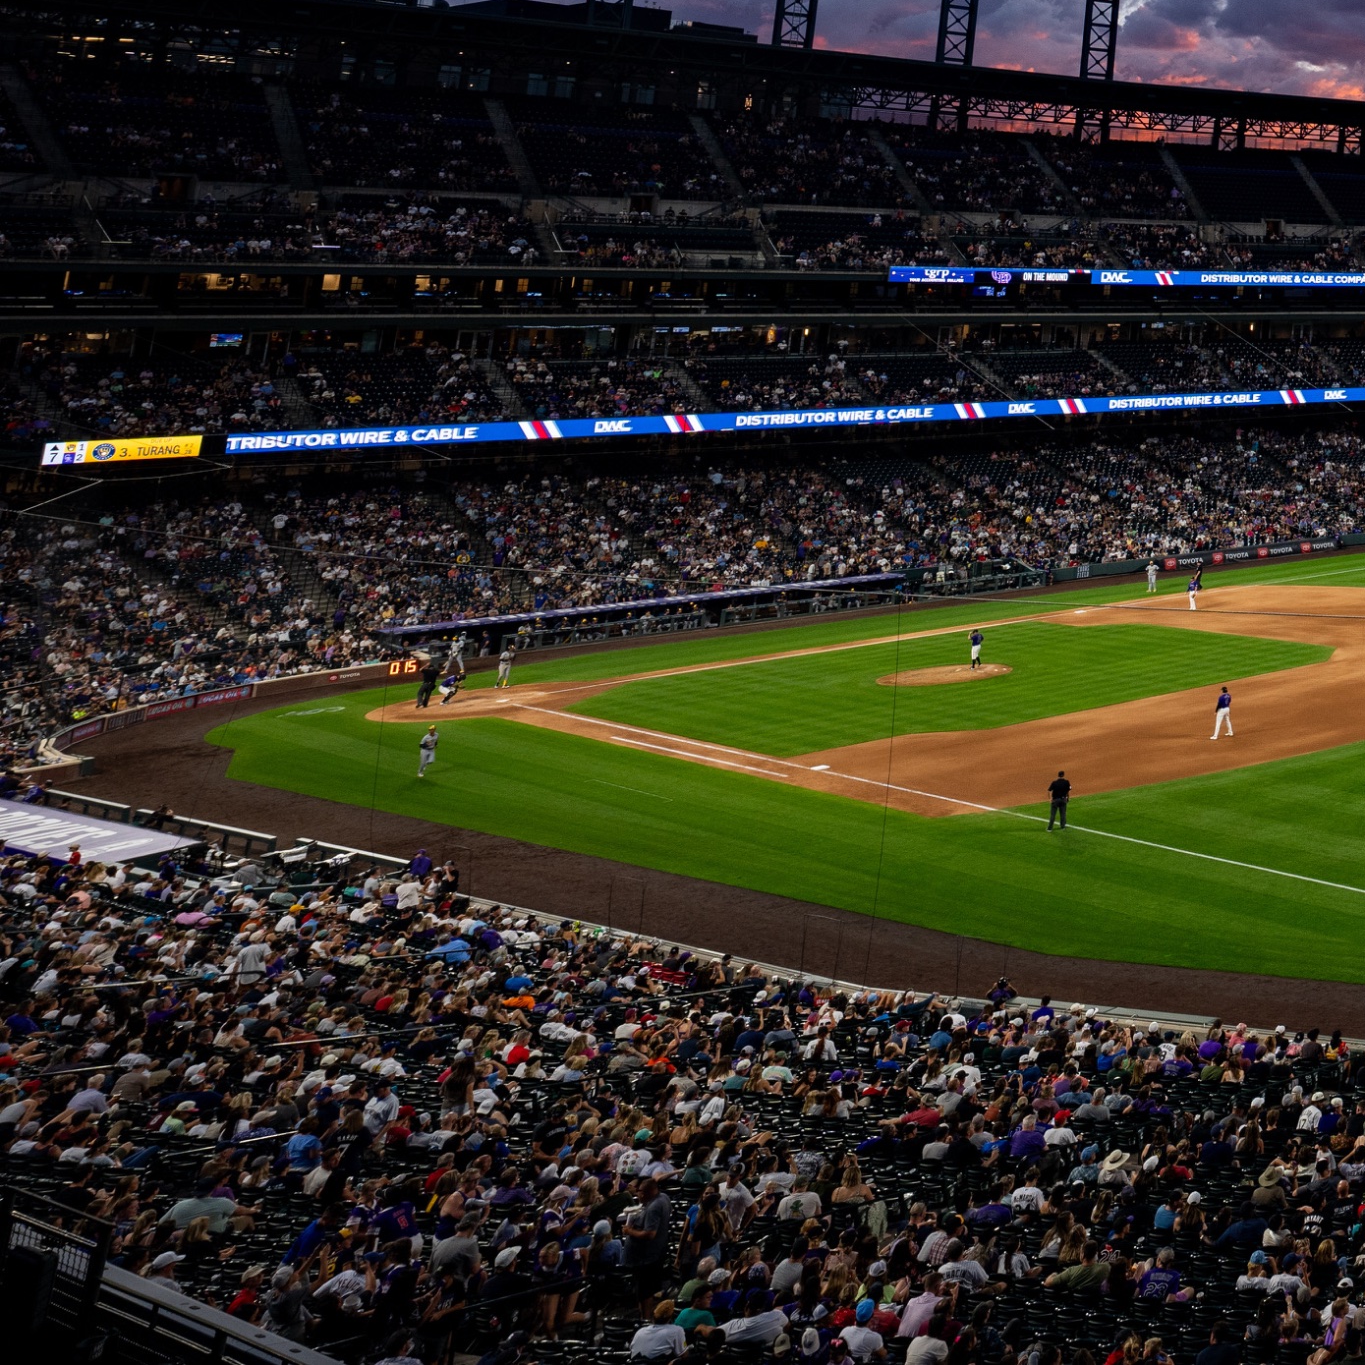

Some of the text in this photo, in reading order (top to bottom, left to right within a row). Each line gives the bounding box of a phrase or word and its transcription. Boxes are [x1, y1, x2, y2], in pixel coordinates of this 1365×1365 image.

[1023, 273, 1068, 281] ON THE MOUND
[1101, 272, 1132, 283] DWC
[1201, 275, 1268, 283] DISTRIBUTOR
[1269, 275, 1293, 283] WIRE
[1302, 275, 1333, 283] CABLE
[1324, 390, 1347, 400] DWC
[1109, 393, 1261, 409] DISTRIBUTOR WIRE & CABLE
[1008, 403, 1036, 414] DWC
[736, 407, 934, 427] DISTRIBUTOR WIRE & CABLE
[594, 420, 632, 433] DWC
[340, 430, 392, 445] WIRE
[393, 430, 408, 442] &
[411, 426, 479, 441] CABLE
[119, 448, 131, 458] 3.
[137, 445, 180, 457] TURANG
[50, 452, 57, 463] 7
[76, 454, 82, 462] 2
[1270, 547, 1293, 555] TOYOTA
[1313, 542, 1335, 550] TOYOTA
[1178, 557, 1203, 566] TOYOTA
[1225, 552, 1249, 560] TOYOTA
[404, 660, 417, 673] 15
[198, 690, 239, 705] LUCAS OIL
